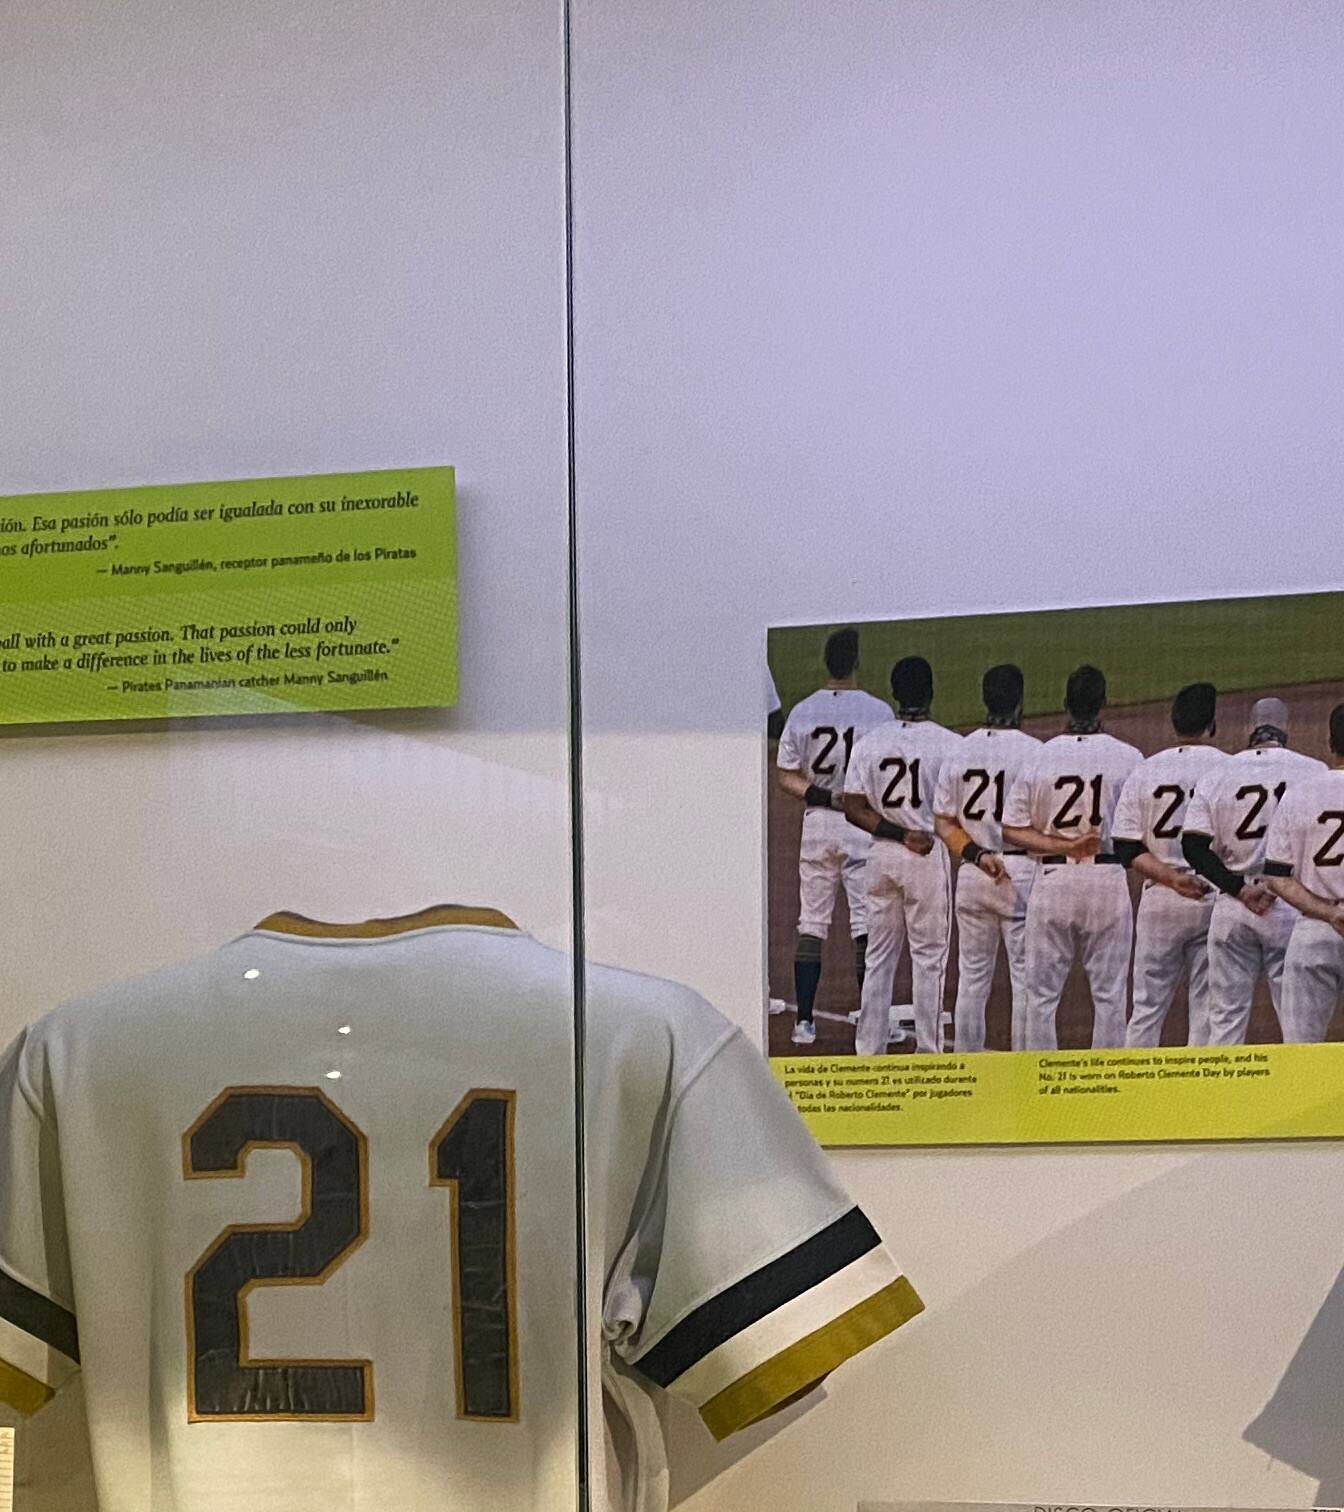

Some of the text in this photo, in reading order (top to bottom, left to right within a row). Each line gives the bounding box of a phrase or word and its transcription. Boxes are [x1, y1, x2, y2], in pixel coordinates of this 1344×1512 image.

[30, 514, 57, 532] Esa
[59, 511, 109, 534] pasión
[112, 507, 144, 527] sólo
[145, 505, 189, 528] podía
[191, 507, 216, 521] ser
[218, 498, 284, 523] igualada
[286, 501, 315, 515] con
[318, 499, 336, 514] su
[339, 490, 419, 512] inexorable
[23, 629, 58, 650] with
[59, 634, 70, 648] a
[70, 630, 113, 651] great
[112, 624, 175, 649] passion.
[178, 622, 216, 642] That
[218, 619, 276, 643] passion
[276, 616, 321, 641] could
[323, 613, 357, 636] only
[879, 757, 921, 809] 21
[962, 768, 1005, 822] 21
[1053, 774, 1103, 829] 21
[182, 1086, 520, 1424] 21
